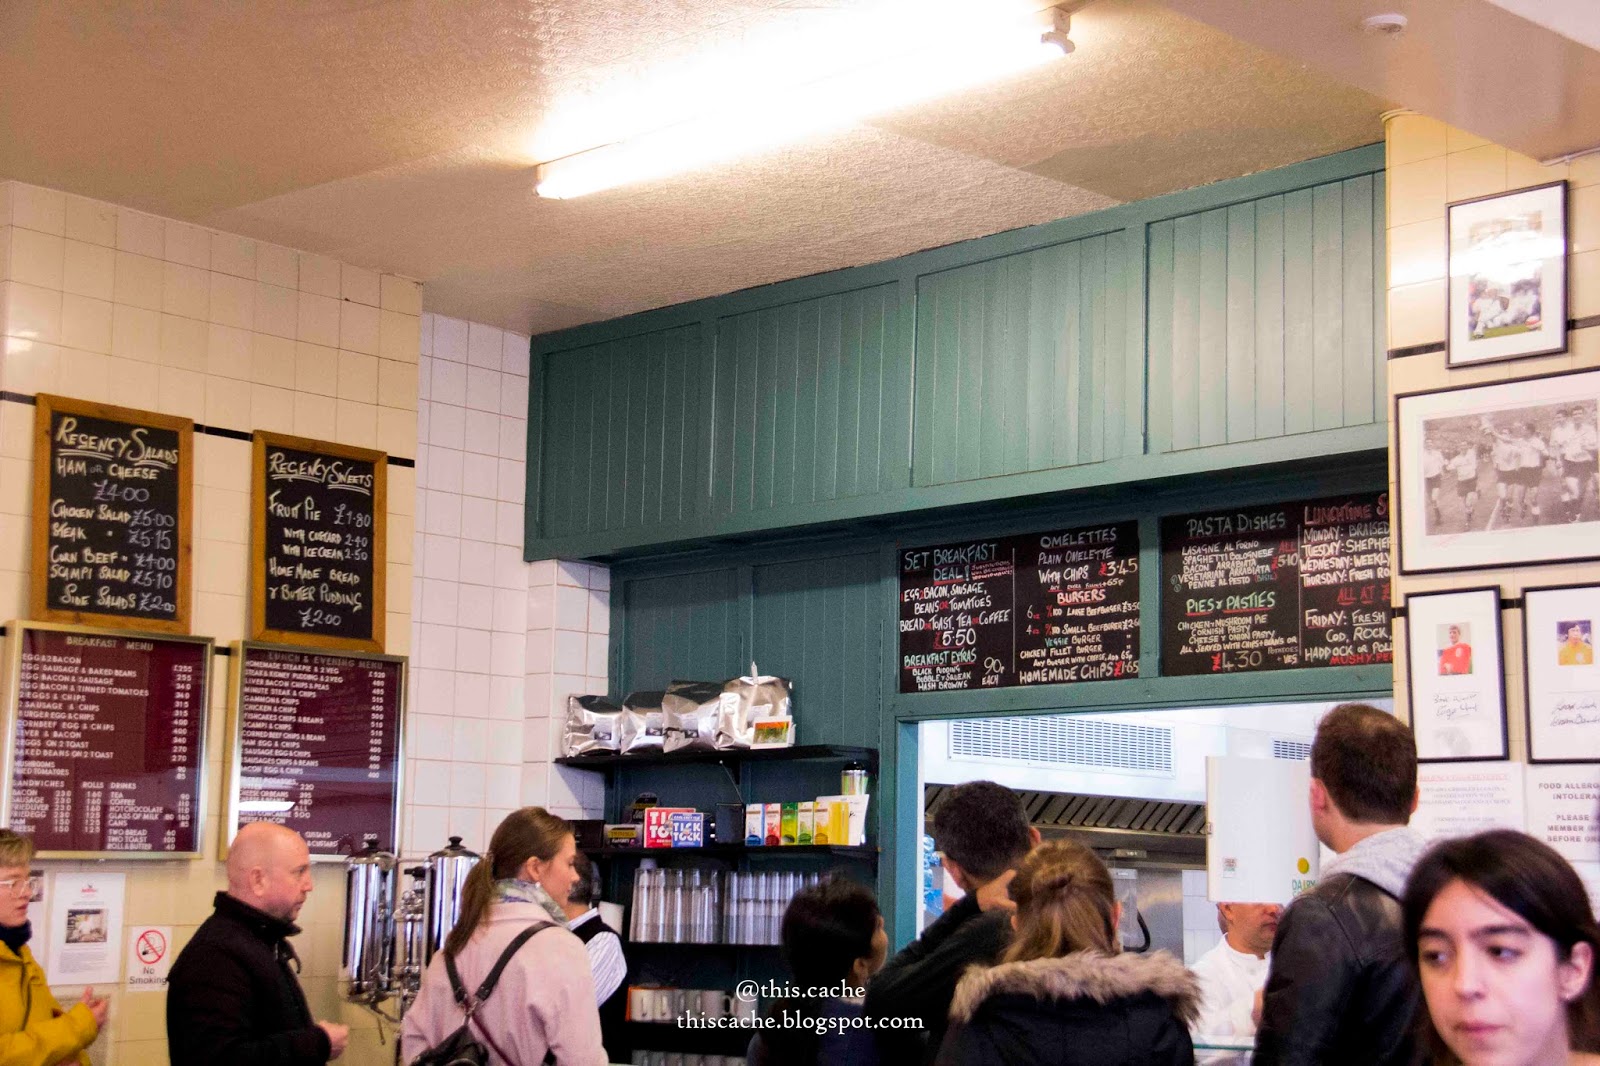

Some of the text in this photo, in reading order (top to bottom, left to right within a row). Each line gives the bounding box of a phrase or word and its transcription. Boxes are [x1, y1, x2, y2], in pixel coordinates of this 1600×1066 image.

[57, 458, 160, 479] HAM CHEESE
[100, 505, 131, 521] SALAD
[304, 496, 321, 520] PIE
[1304, 504, 1372, 525] LUNCHTIME
[1187, 513, 1286, 536] PASTA DISHES
[52, 523, 86, 541] STEAK
[1041, 528, 1117, 548] OMELETTES
[51, 545, 78, 563] CORN
[84, 550, 118, 563] BEEF
[1182, 540, 1259, 555] LASAGNE AL FORNO
[904, 551, 930, 570] SET
[934, 543, 997, 566] BREAKFAST
[1038, 547, 1114, 565] PLAIN OMELETTE
[1183, 548, 1275, 565] SPAGHETTI BOLOGNESE
[51, 564, 92, 579] SCAMPI
[100, 564, 131, 581] SALAD
[1038, 569, 1060, 583] WITH
[1063, 565, 1089, 581] CHIPS
[1183, 564, 1209, 574] BACON
[1349, 568, 1373, 582] FRESH
[330, 569, 360, 586] BREAD
[1178, 572, 1225, 584] VEGETARIAN
[1188, 576, 1250, 589] PENNE AL PESTO
[61, 583, 89, 606] SIDE
[320, 583, 362, 612] PUDDING
[1057, 589, 1106, 604] BURGERS
[1338, 585, 1375, 601] ALL AT
[915, 595, 991, 614] BEANS OR TOMATOES
[1186, 591, 1275, 613] PIES PASTIES
[900, 609, 1011, 632] BREAD TEA COFFEE
[1255, 614, 1268, 623] PIE
[1352, 609, 1385, 623] FRESH
[1062, 623, 1086, 634] SMALL
[1191, 624, 1250, 637] CORNISH PASTY
[66, 637, 153, 651] BREAKFAST MENU
[1045, 635, 1101, 647] VEGGIE BURGER
[1189, 630, 1275, 645] CHEESE ONION PASTY
[1020, 645, 1102, 659] CHICKEN FILLET BURGER
[1180, 644, 1221, 655] ALL SERVED
[1305, 647, 1353, 661] HADDOCK
[53, 655, 82, 664] BACON
[269, 653, 383, 669] LUNCH EVENING MENU
[904, 648, 976, 667] BREAKFAST EXTRAS
[21, 663, 137, 677] EGG SAUSAGE BAKED BEANS
[913, 665, 960, 675] BLACK PUDDING
[1081, 662, 1113, 679] CHIPS
[21, 672, 114, 685] EGG BACON SAUSAGE
[265, 679, 289, 688] BACON
[916, 672, 971, 683] BUBBLE SQUEAK
[982, 675, 999, 685] EACH
[20, 682, 149, 697] EGG BACON TINNED TOMATOES
[244, 687, 268, 695] MINUTE
[918, 680, 967, 690] HASH BROWNS
[62, 693, 86, 701] CHIPS
[25, 701, 100, 712] SAUSAGE CHIPS
[62, 721, 115, 731] EGG CHIPS
[53, 730, 82, 738] BACON
[66, 741, 89, 749] TOAST
[43, 749, 70, 757] BEANS
[34, 768, 69, 776] TOMATOES
[12, 780, 136, 790] SANDWICHES ROLLS DRINKS
[107, 819, 127, 827] CANS
[673, 823, 700, 831] TICK
[673, 833, 700, 841] TOCK
[130, 976, 167, 985] Smoking
